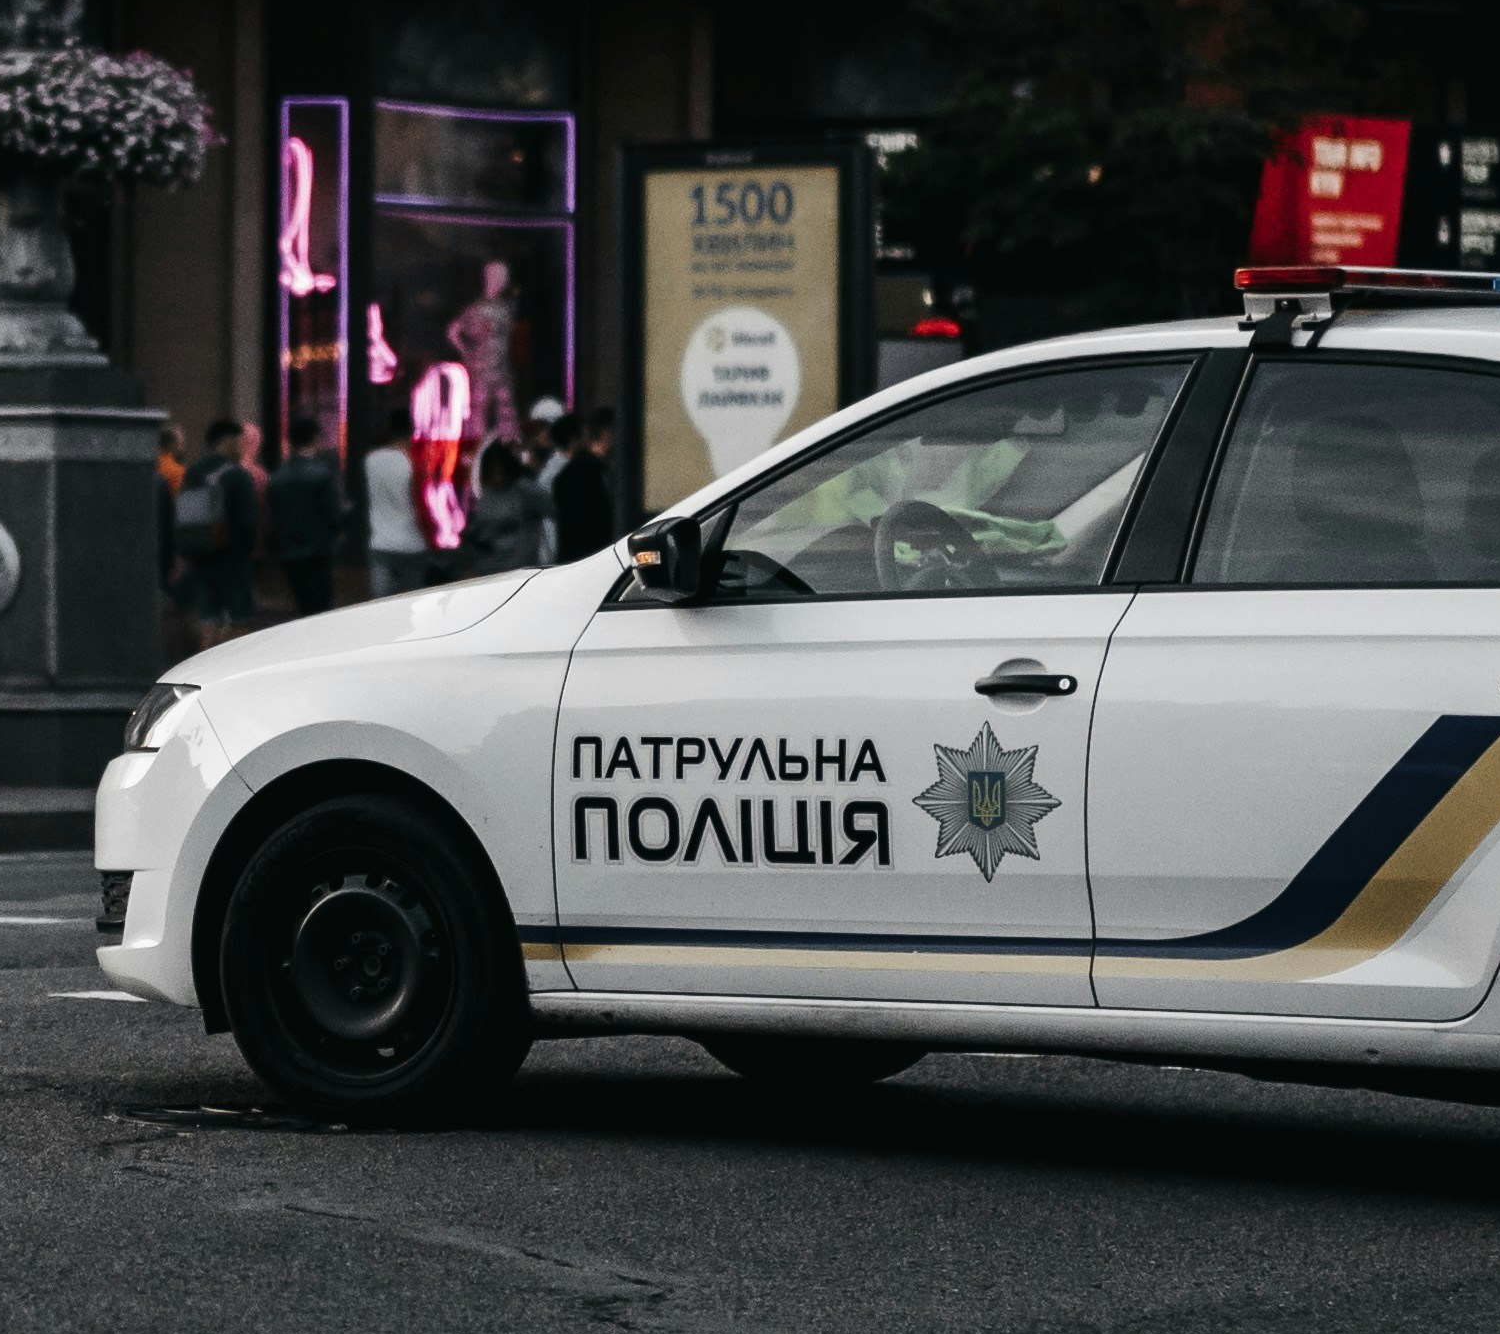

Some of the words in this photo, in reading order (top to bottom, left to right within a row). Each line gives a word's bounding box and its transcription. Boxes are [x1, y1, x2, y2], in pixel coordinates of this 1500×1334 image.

[689, 182, 795, 228] 1500
[572, 735, 888, 783] ПАТРУЛЬНА
[574, 795, 892, 867] ПОЛІЦІЯ
